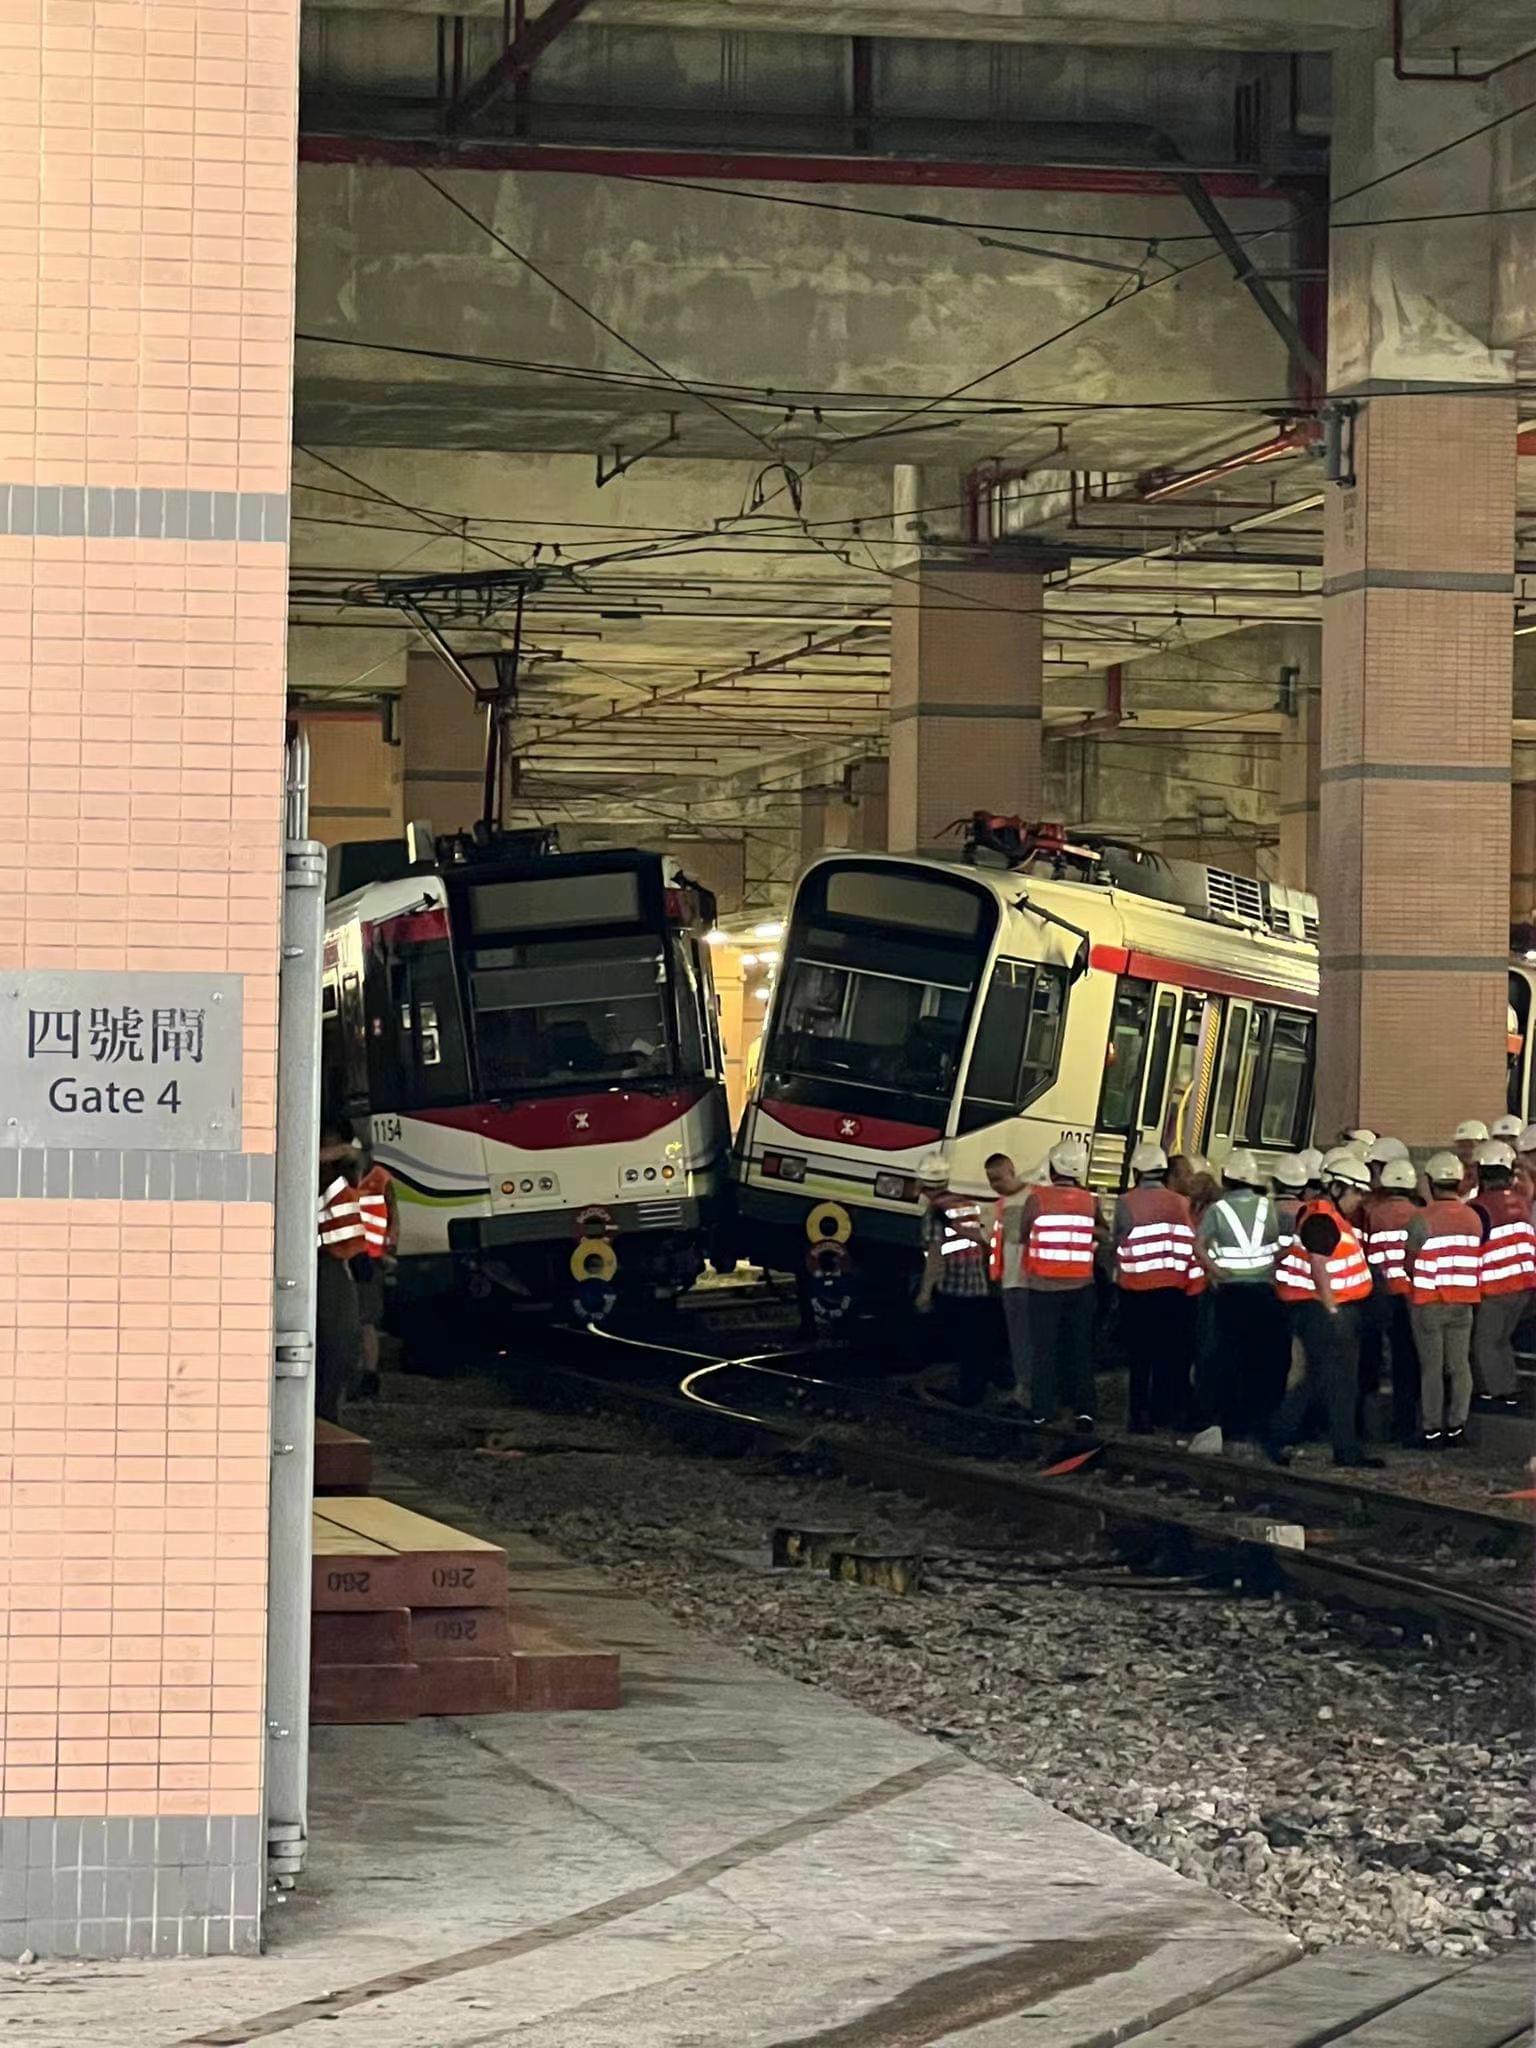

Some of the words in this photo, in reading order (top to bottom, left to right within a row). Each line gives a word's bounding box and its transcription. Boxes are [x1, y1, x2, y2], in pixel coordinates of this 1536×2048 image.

[28, 1005, 206, 1064] 四號閘
[48, 1077, 145, 1114] Gate
[156, 1080, 182, 1114] 4
[373, 1118, 403, 1142] 1154
[432, 1567, 476, 1590] 260
